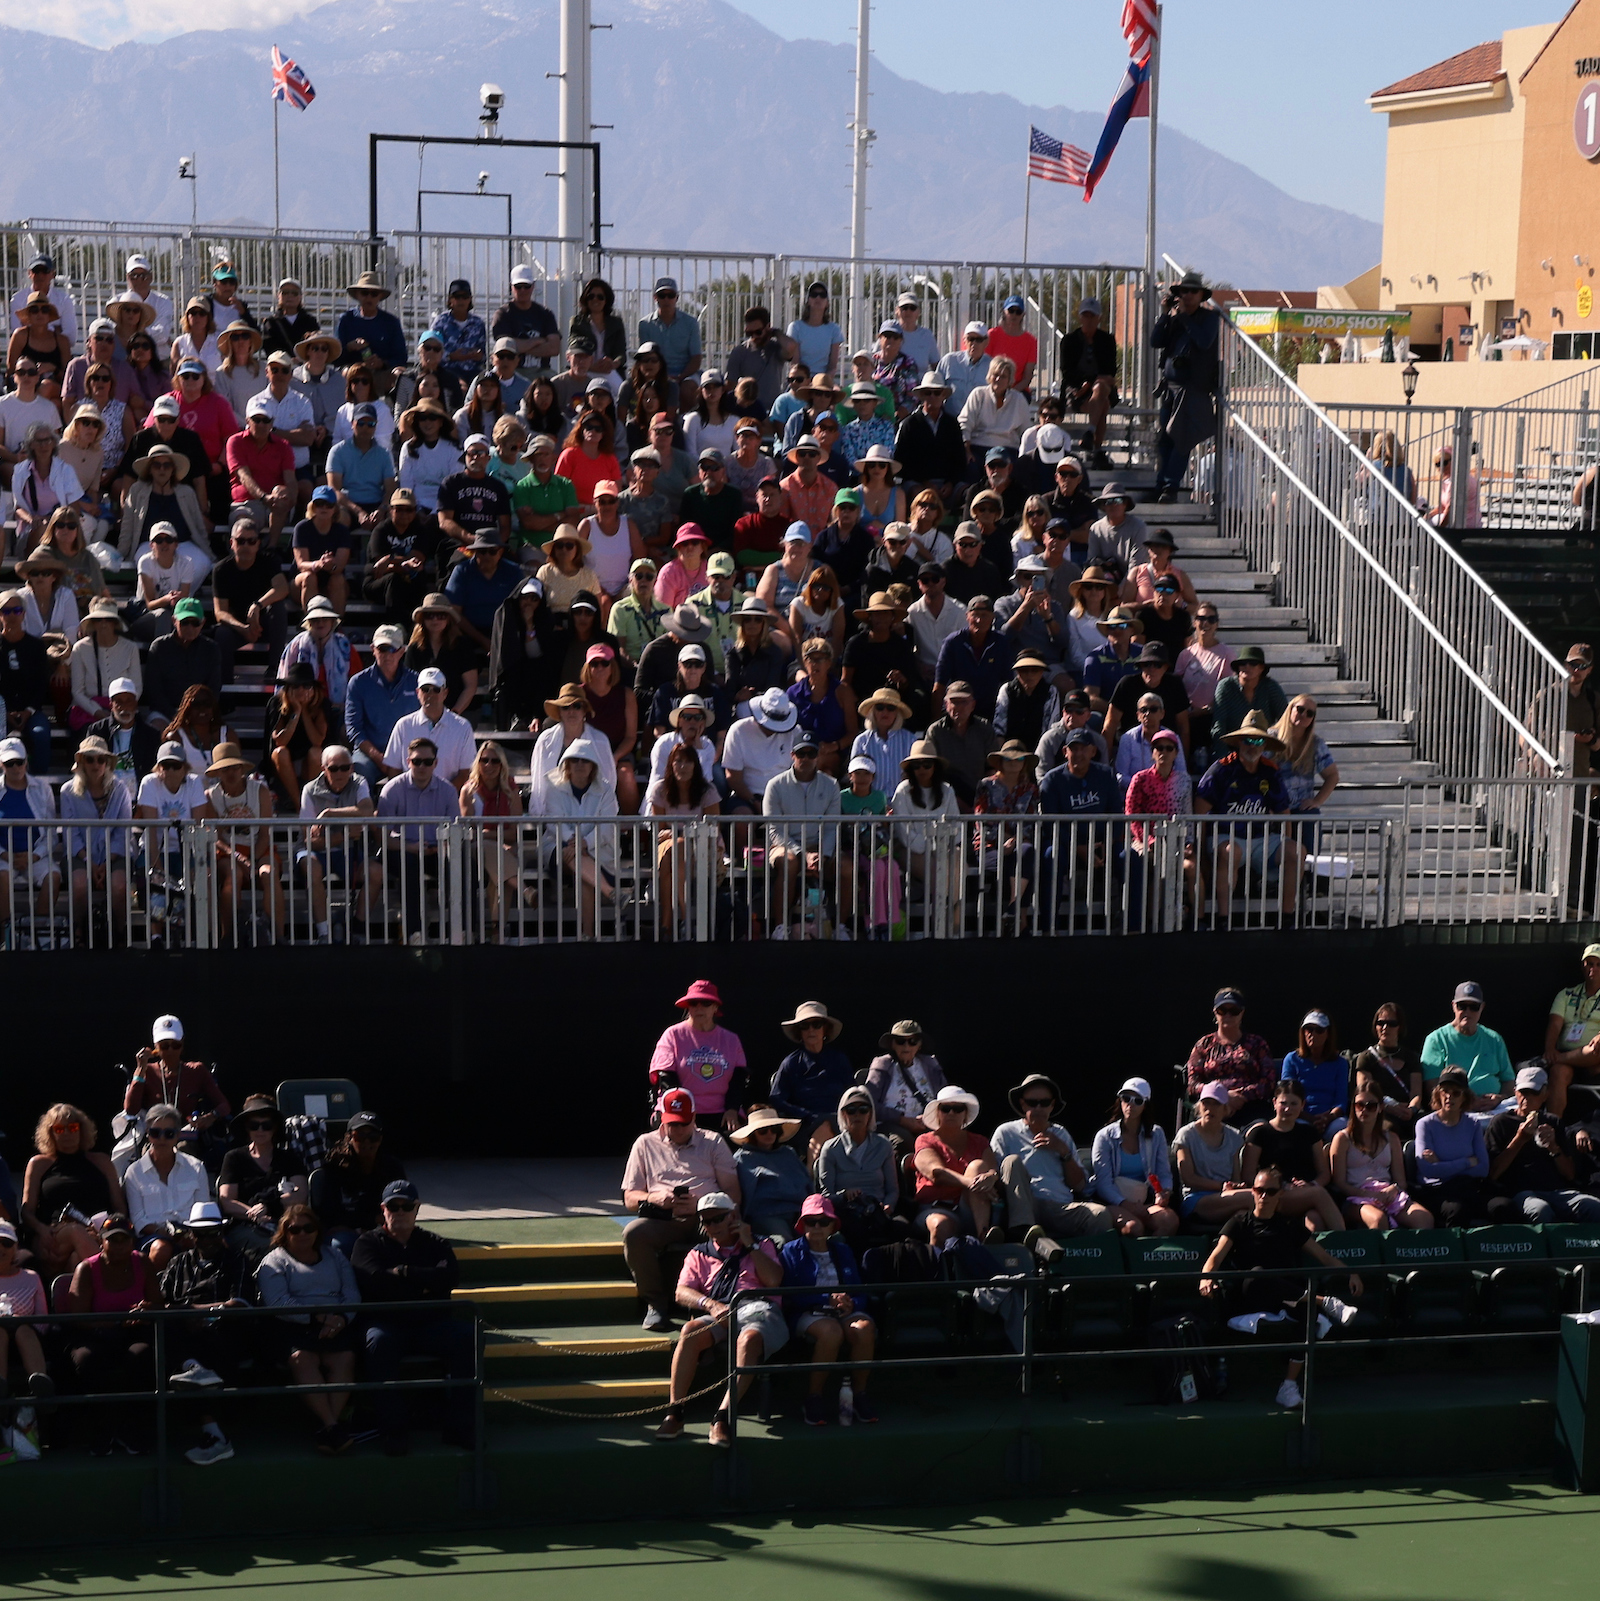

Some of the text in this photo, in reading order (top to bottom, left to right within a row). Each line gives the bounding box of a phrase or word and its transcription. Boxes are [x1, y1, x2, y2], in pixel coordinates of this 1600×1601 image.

[1584, 92, 1597, 146] 1
[1303, 314, 1387, 330] DROP SHOT
[1063, 1247, 1102, 1259] ERVED
[1327, 1247, 1366, 1259] ERVED
[1396, 1246, 1449, 1258] RESERVED
[1479, 1241, 1532, 1253] RESERVED
[1143, 1250, 1199, 1262] RESERVED
